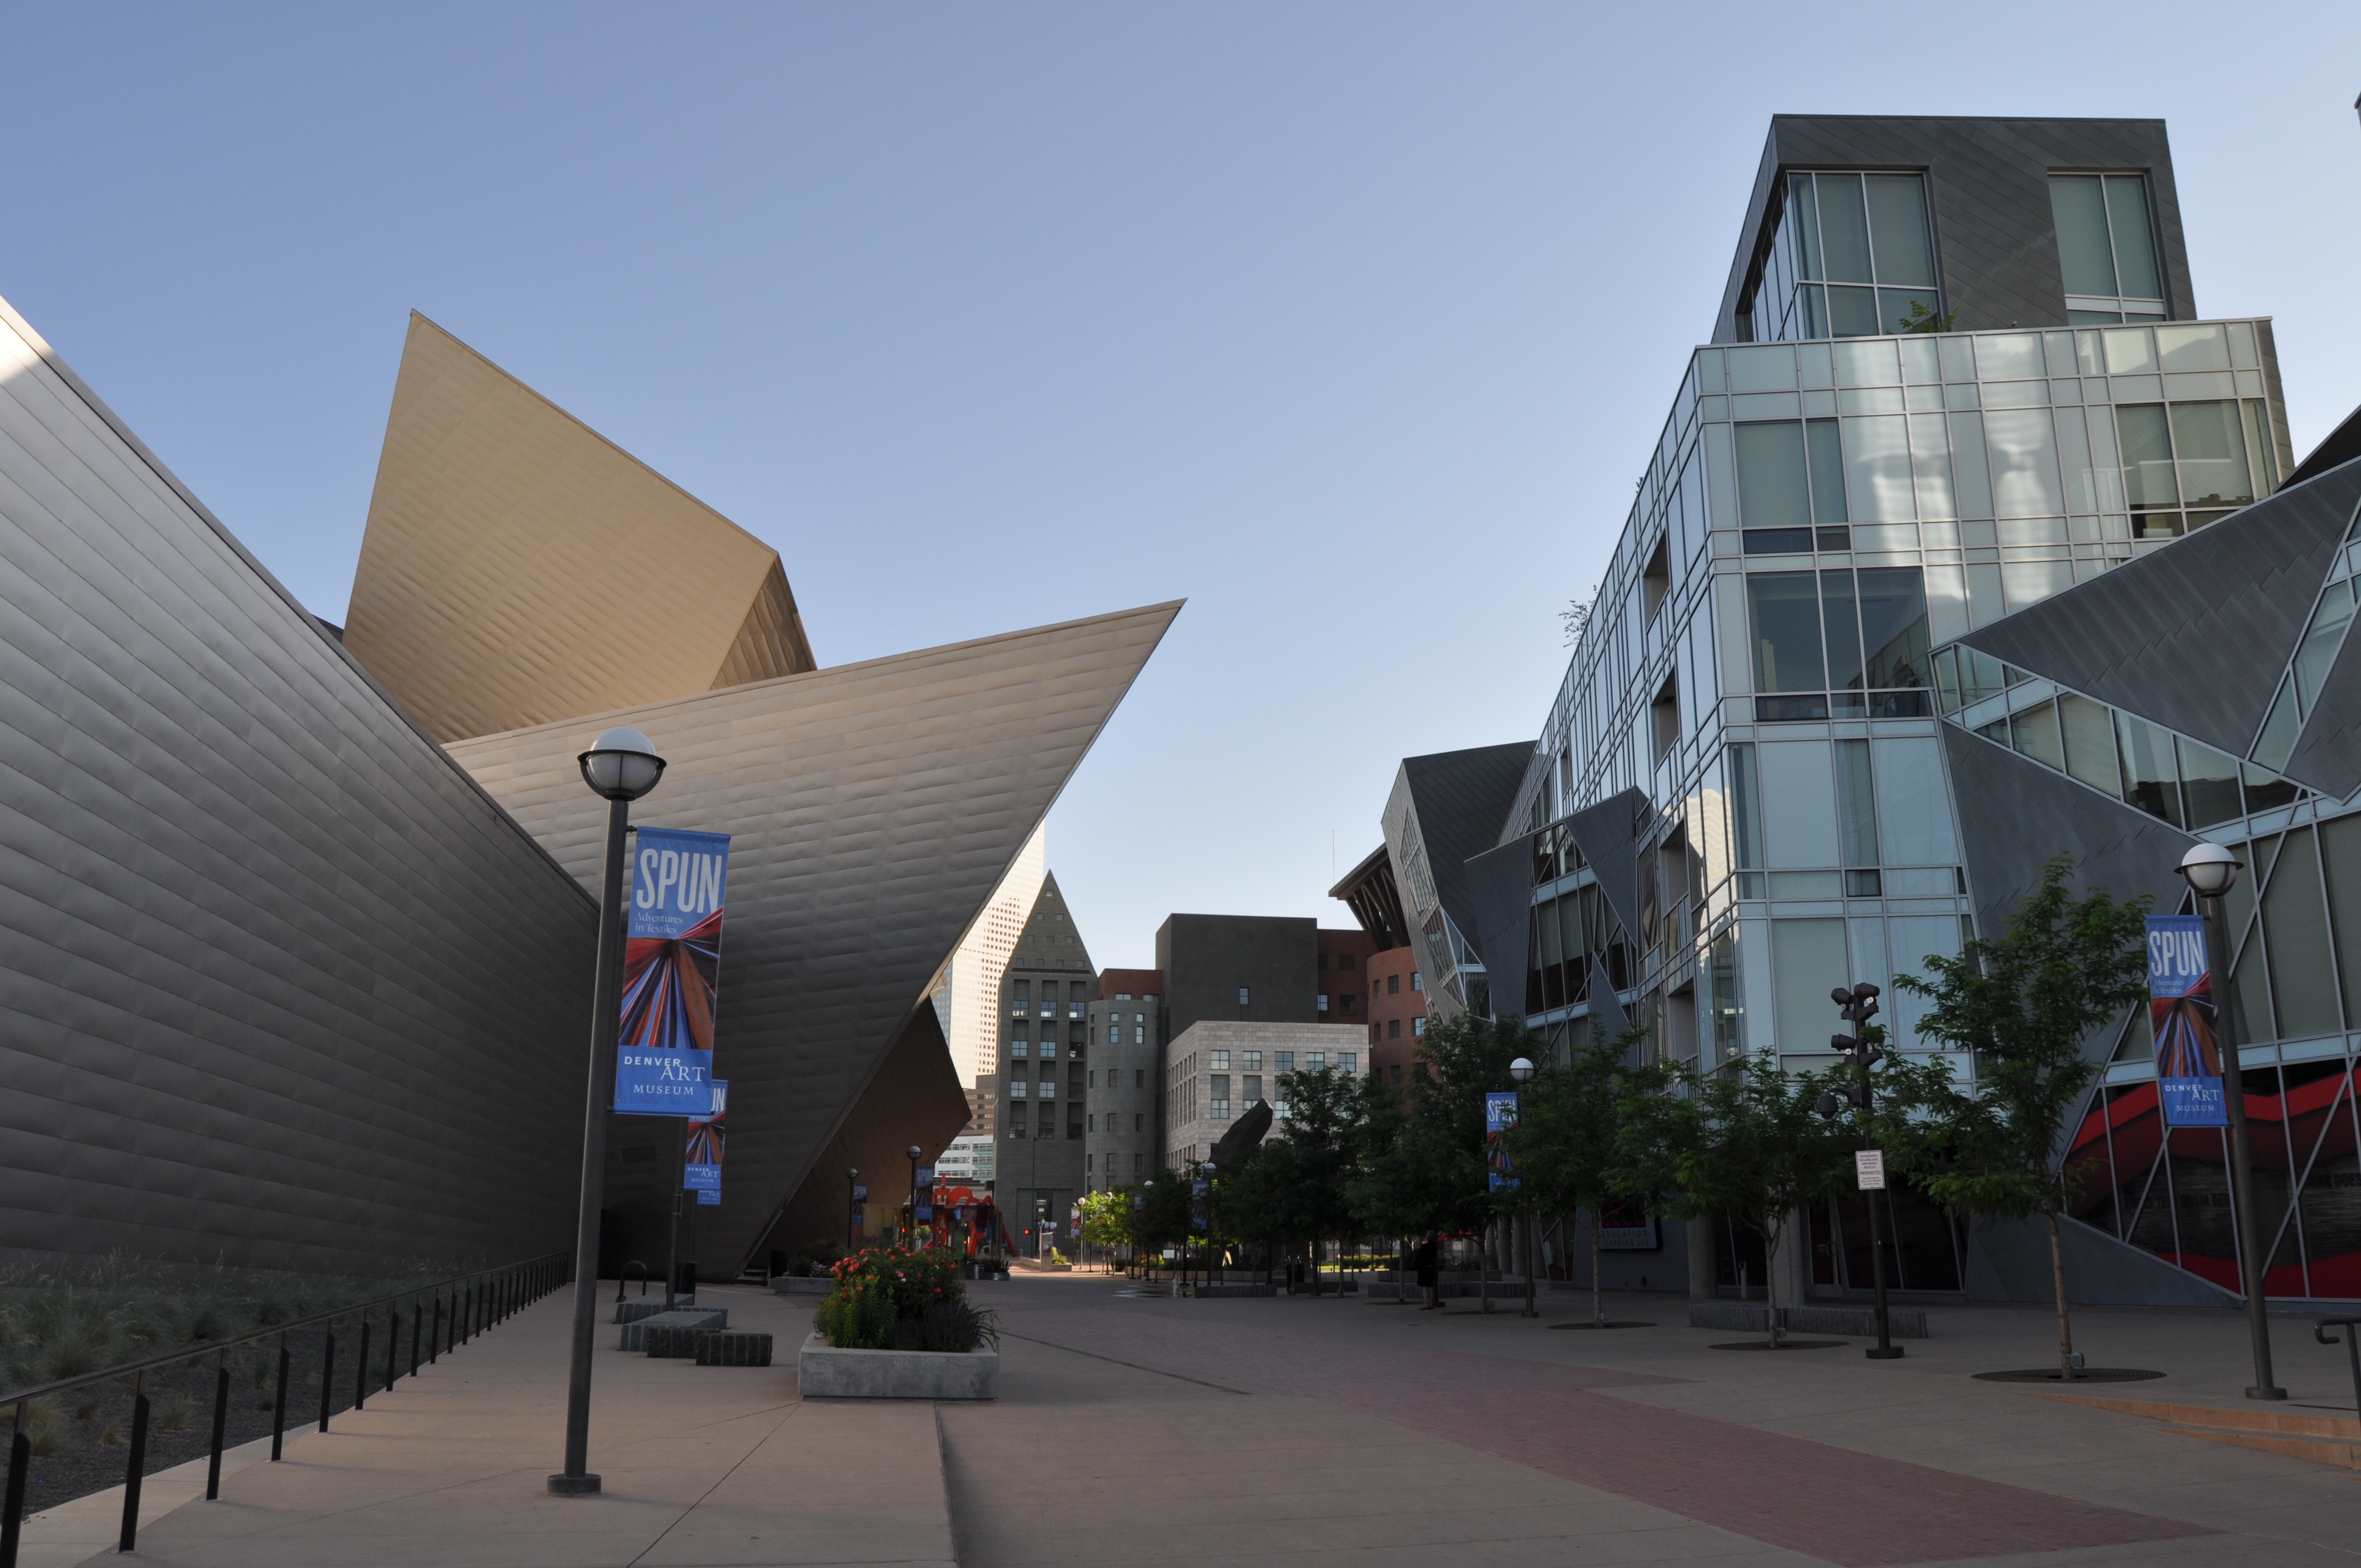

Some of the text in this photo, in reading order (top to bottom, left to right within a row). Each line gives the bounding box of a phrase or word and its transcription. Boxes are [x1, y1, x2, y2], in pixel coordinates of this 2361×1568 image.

[636, 848, 722, 913] SPUN
[635, 913, 683, 923] Adventures
[646, 923, 677, 933] Textiles
[2149, 930, 2205, 976] SPUN
[624, 1056, 681, 1066] DENVER
[660, 1065, 705, 1081] ART
[633, 1085, 694, 1095] MUSEUM
[2192, 1089, 2219, 1101] ART
[917, 1169, 933, 1182] SPUN
[854, 1186, 866, 1195] SPUN
[1602, 1229, 1647, 1238] EDUCATION
[1603, 1238, 1649, 1247] LEARNING LAB
